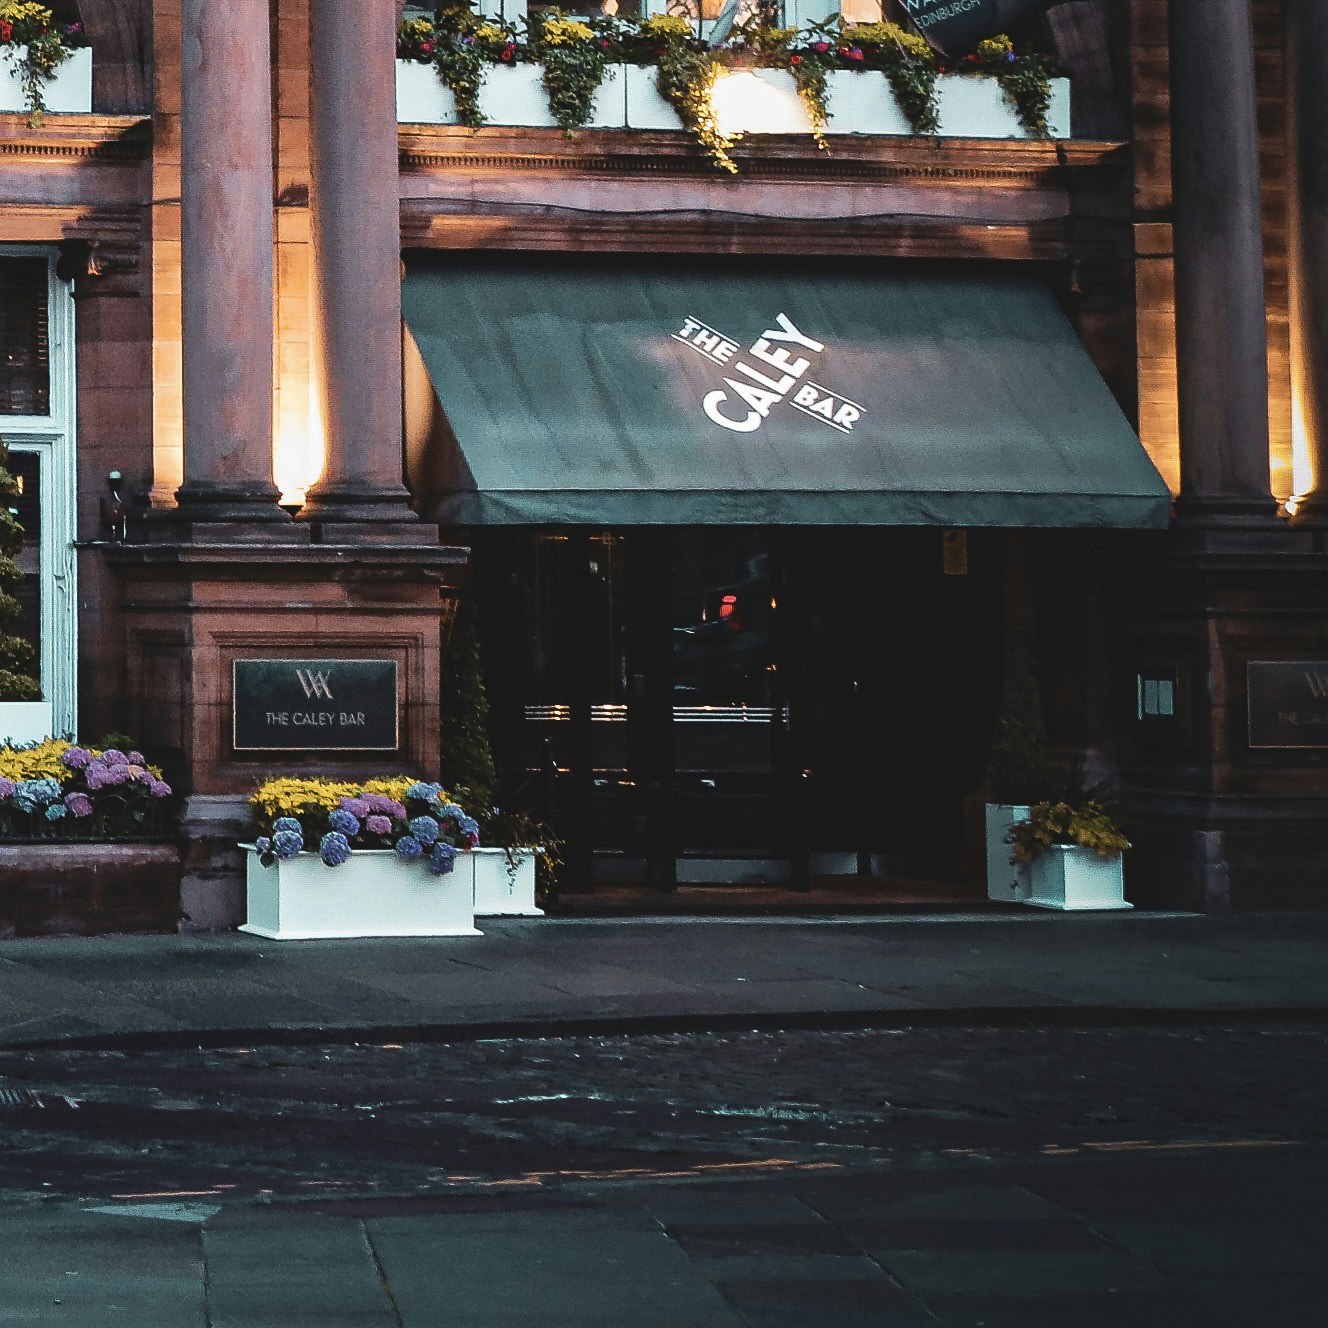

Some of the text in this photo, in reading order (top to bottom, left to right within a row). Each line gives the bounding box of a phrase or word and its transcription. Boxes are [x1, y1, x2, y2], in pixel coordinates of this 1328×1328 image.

[677, 317, 739, 364] THE
[702, 312, 825, 433] CALEY
[793, 383, 862, 430] BAR
[266, 712, 365, 725] THE CALEY BAR
